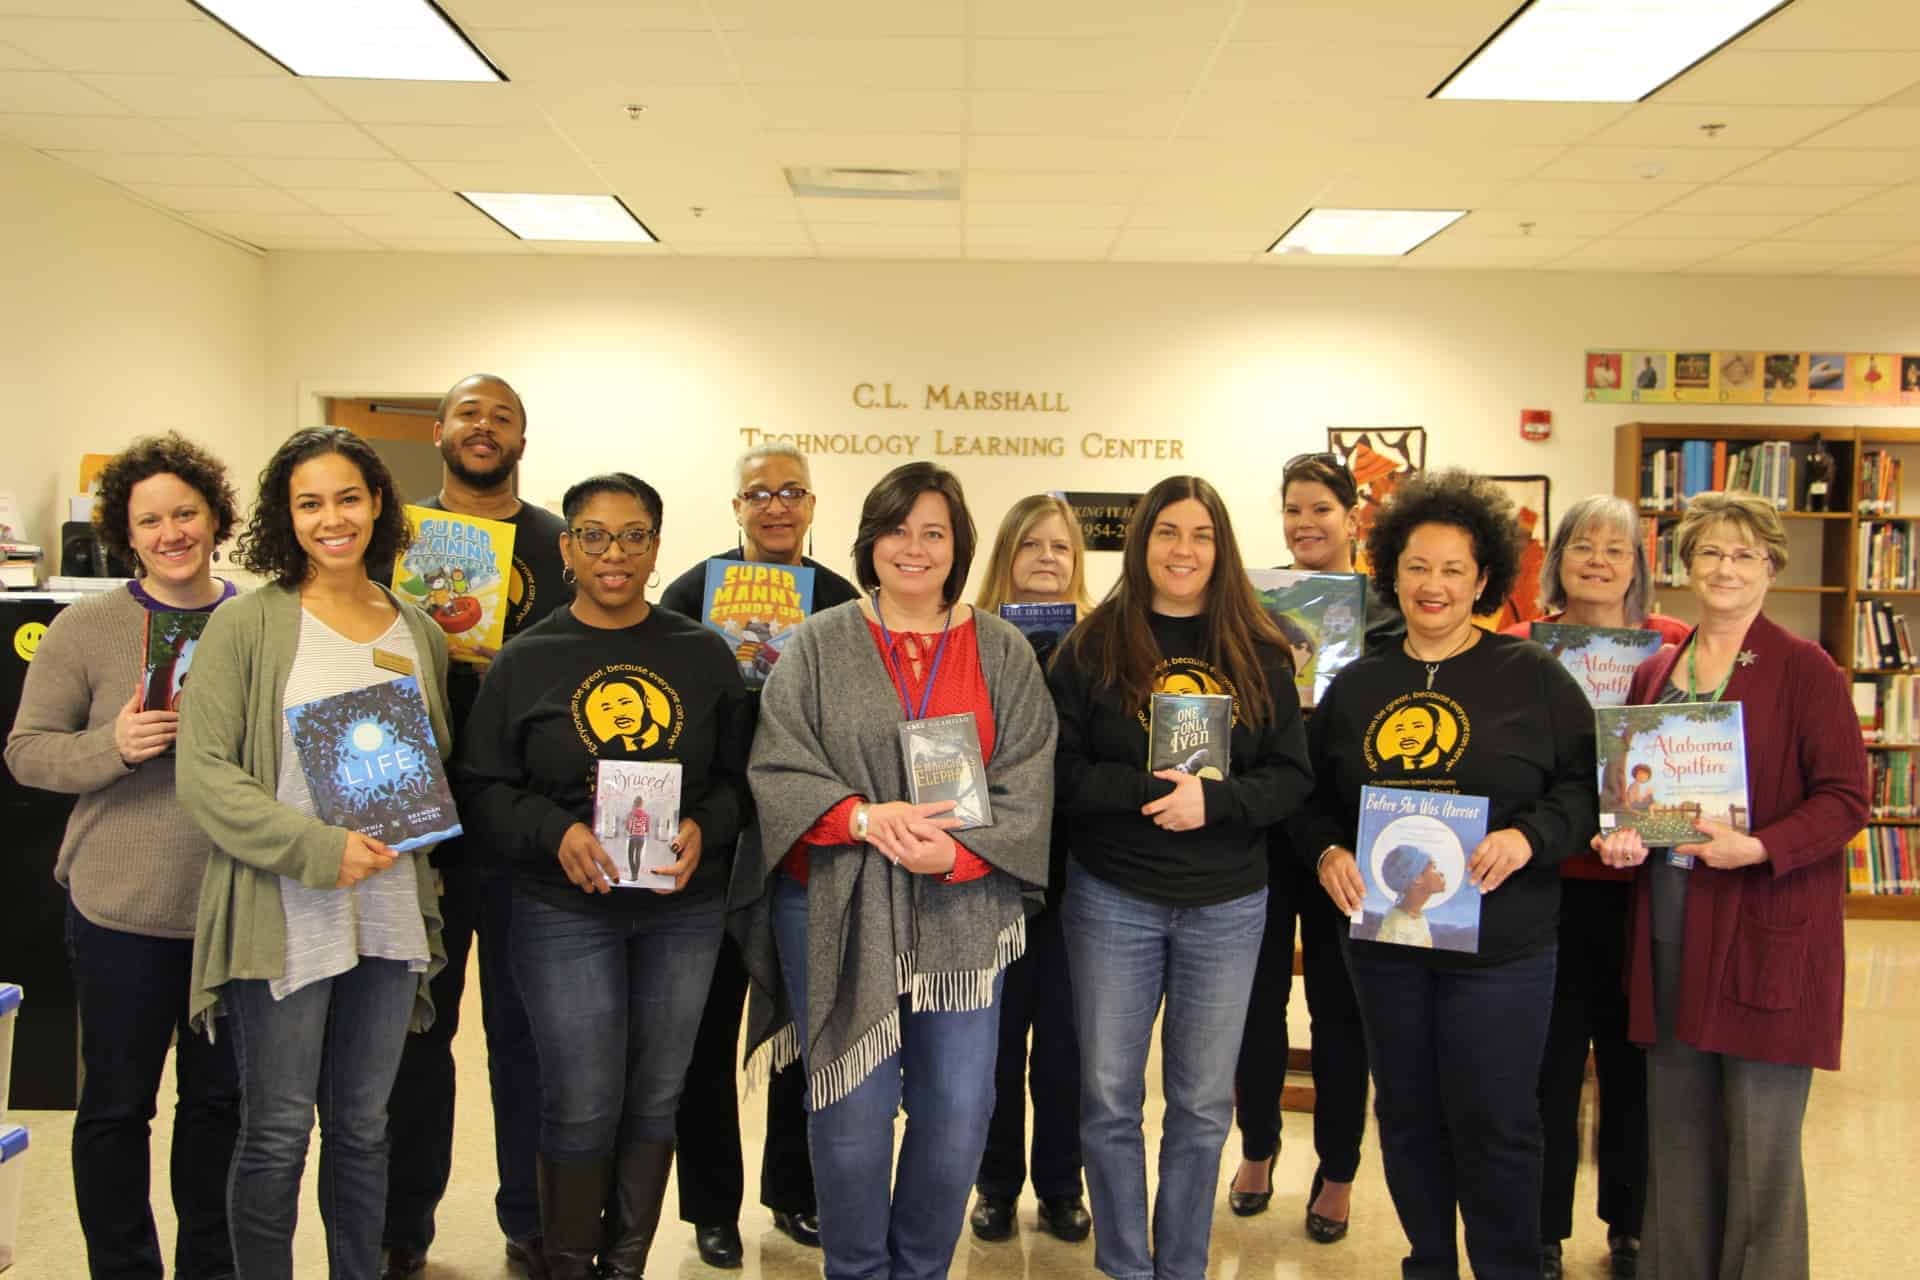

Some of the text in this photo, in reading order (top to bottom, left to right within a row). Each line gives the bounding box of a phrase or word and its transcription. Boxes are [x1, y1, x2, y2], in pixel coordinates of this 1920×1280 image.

[852, 382, 908, 409] C.L.
[419, 518, 492, 547] SUPER
[723, 564, 797, 594] SUPER
[712, 583, 801, 610] MANNY
[708, 602, 775, 622] STANDS
[606, 663, 649, 675] because
[675, 703, 685, 720] can
[1412, 691, 1451, 704] because
[1583, 675, 1629, 699] Spitfi
[1177, 705, 1199, 722] ONE
[1180, 718, 1209, 736] ONLY
[1170, 730, 1209, 754] Ivan
[1646, 734, 1734, 756] Alabama
[344, 748, 415, 785] LIFE
[1662, 754, 1729, 783] Spitfire
[1366, 792, 1480, 819] Before She Was Harriet
